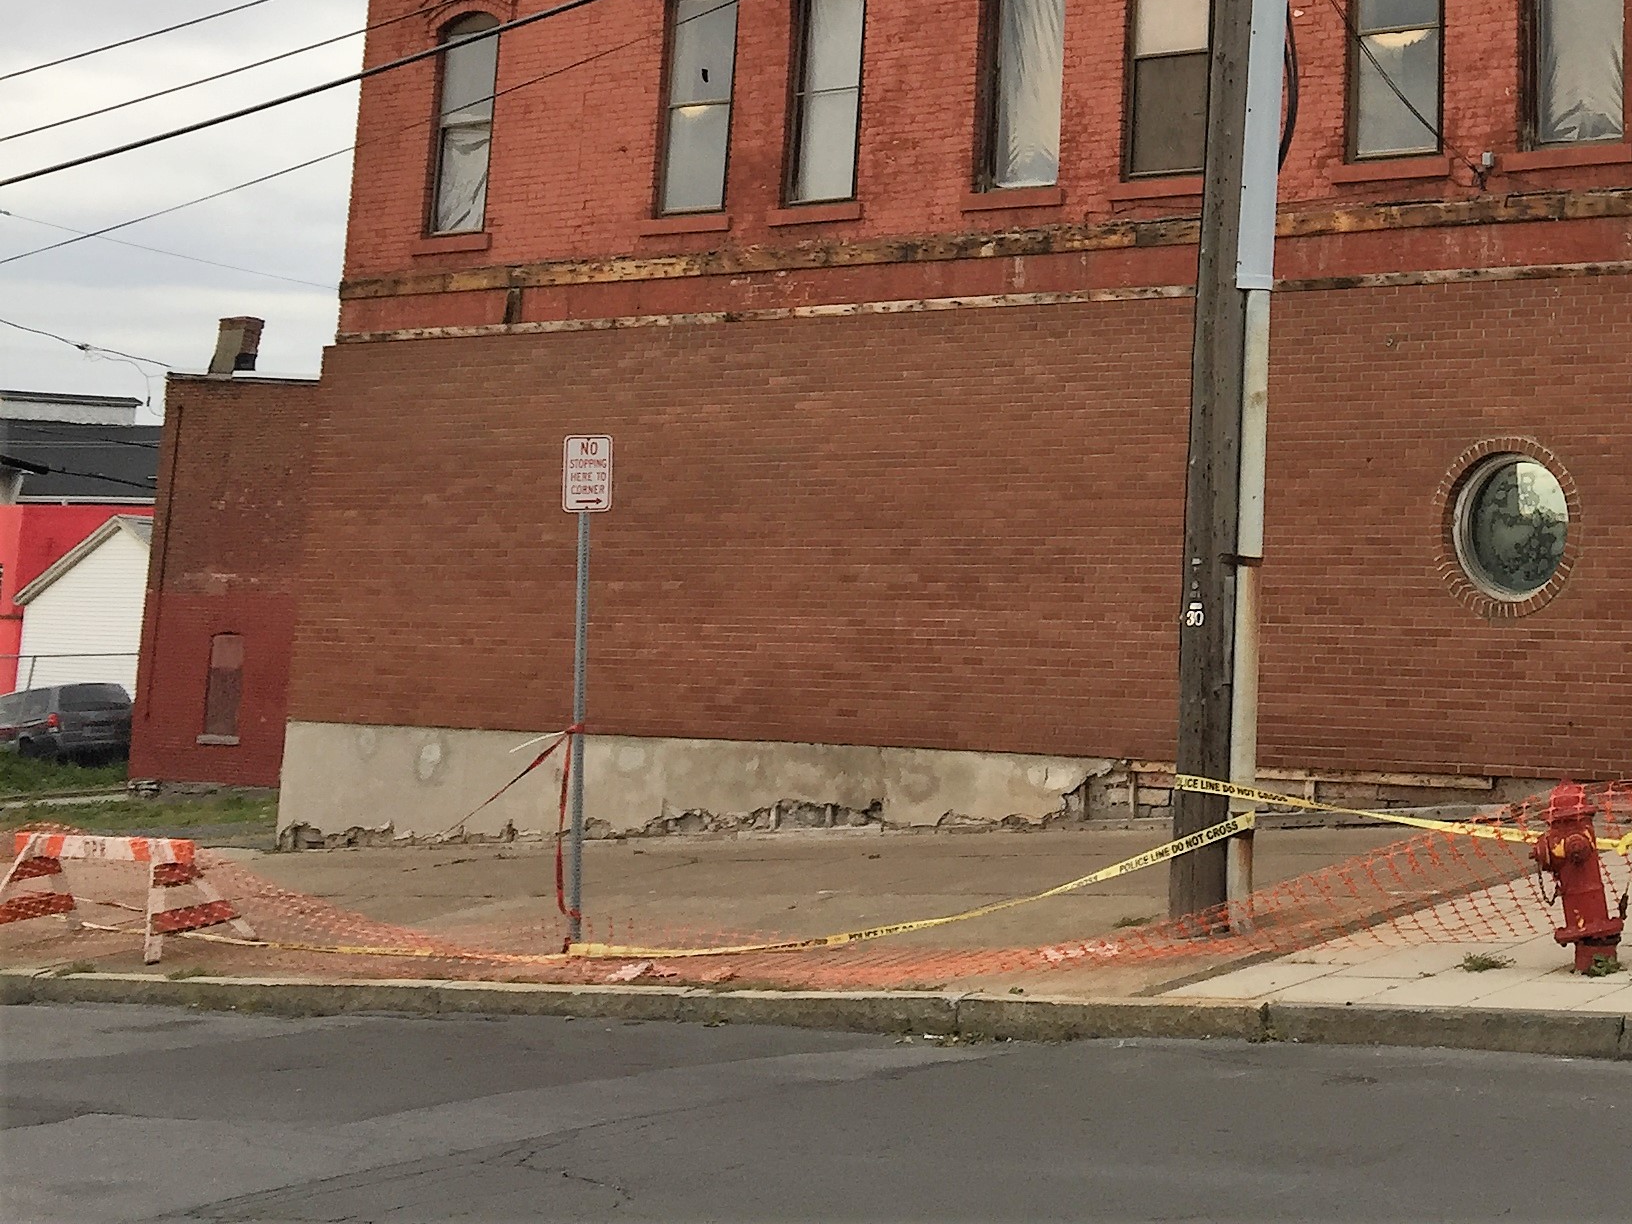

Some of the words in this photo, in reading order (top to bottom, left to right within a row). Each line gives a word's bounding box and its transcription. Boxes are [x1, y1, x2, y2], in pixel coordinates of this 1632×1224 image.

[580, 442, 598, 455] NO
[569, 458, 607, 469] STOPPING
[570, 472, 593, 482] HERE
[596, 472, 607, 482] TO
[570, 484, 605, 495] CORNER
[1186, 610, 1204, 627] 30
[1119, 857, 1149, 873] POLICE
[1150, 847, 1171, 862] LINE
[1171, 840, 1185, 854] DO
[1185, 832, 1204, 848] NOT
[1205, 820, 1239, 840] CROSS
